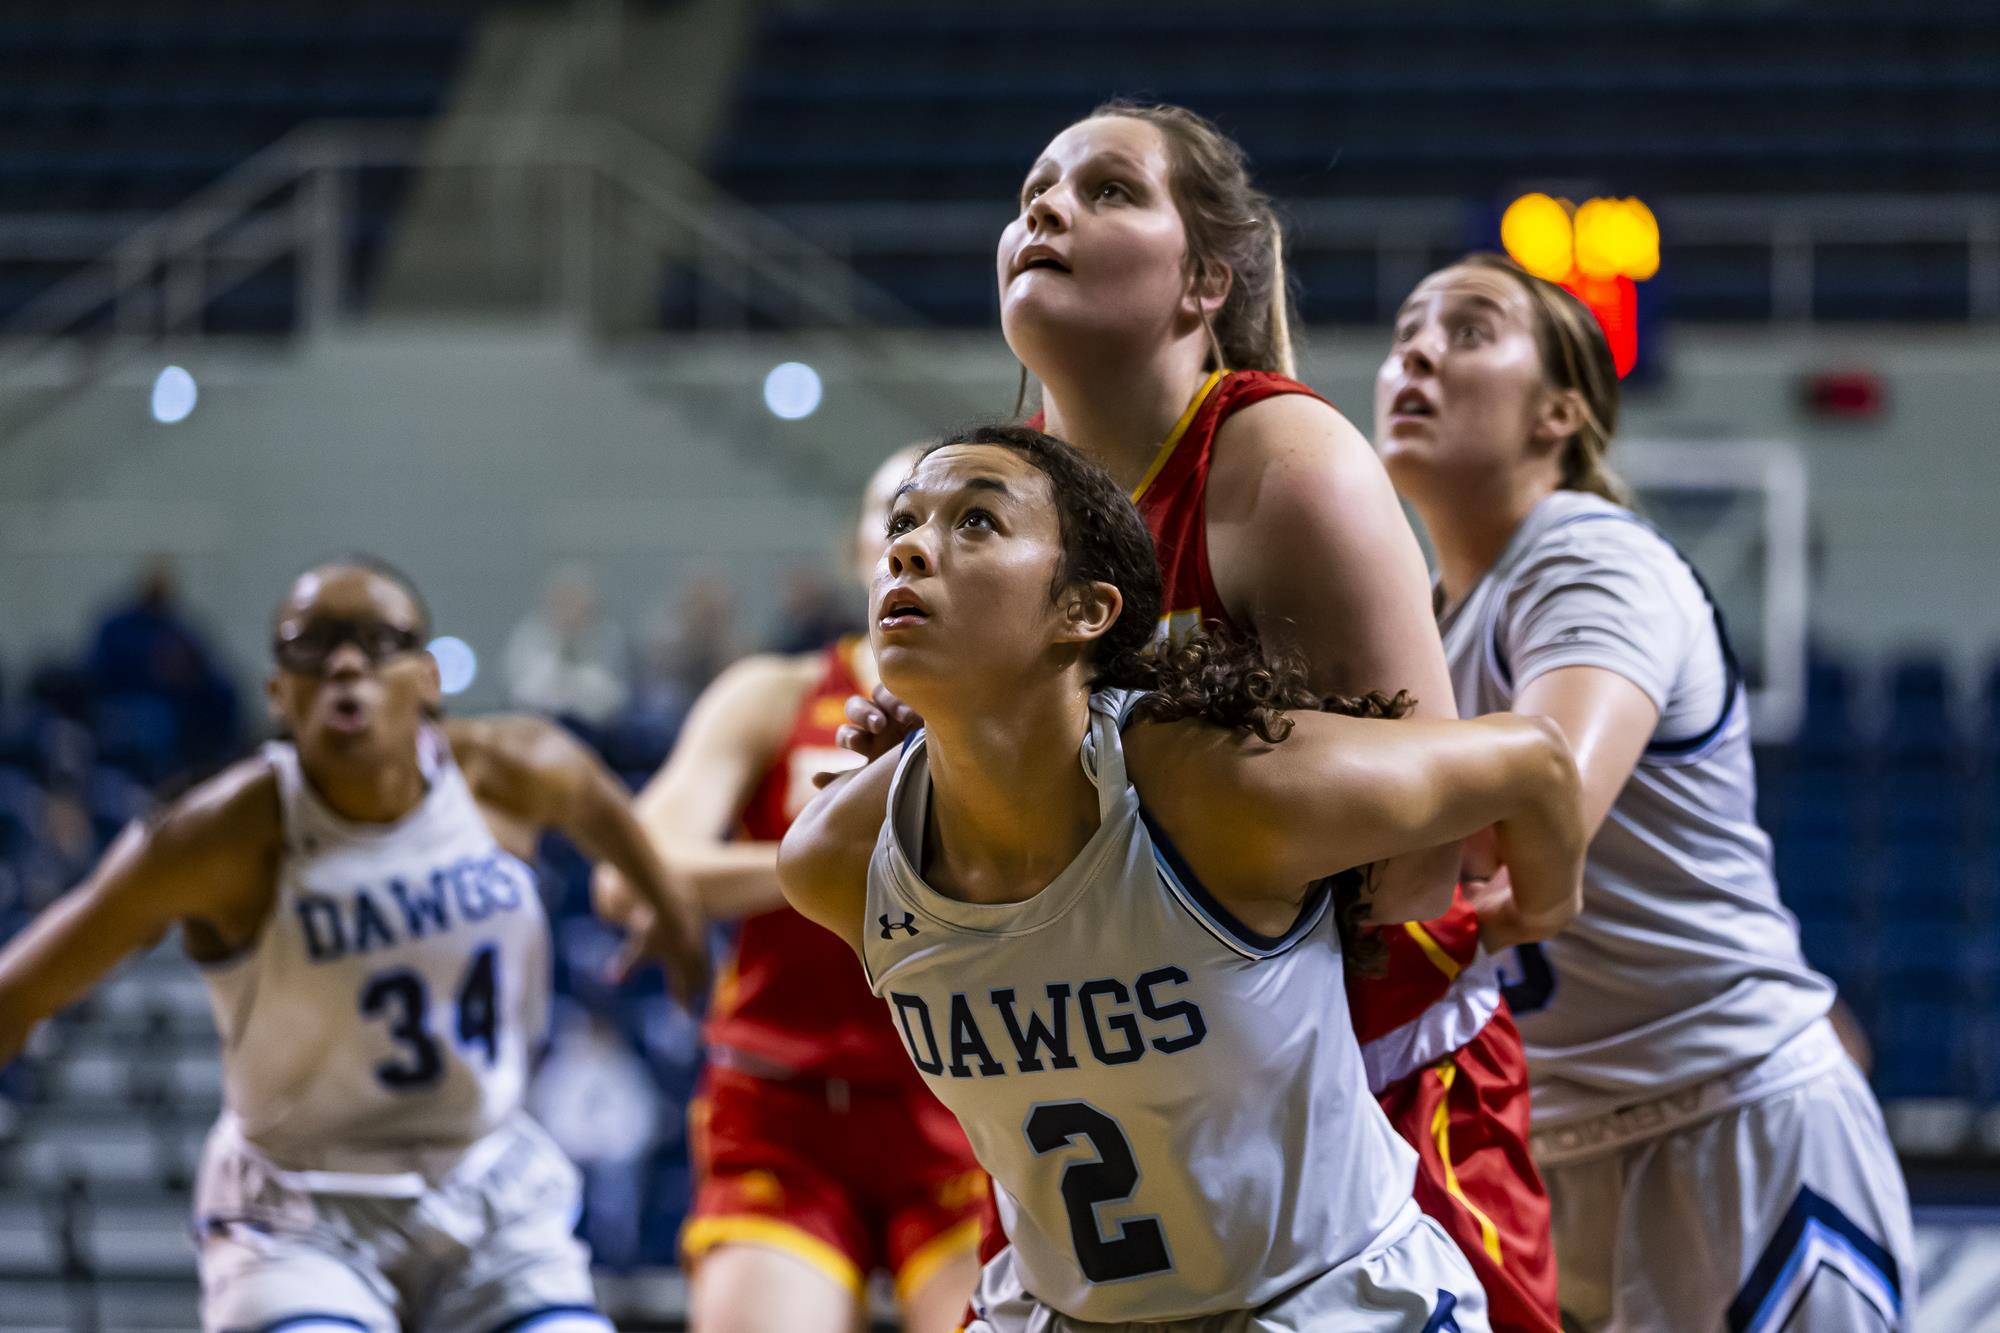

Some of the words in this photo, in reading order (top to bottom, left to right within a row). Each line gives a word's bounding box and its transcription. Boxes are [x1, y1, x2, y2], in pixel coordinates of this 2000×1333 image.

[297, 857, 521, 963] DAWGS
[360, 942, 498, 1090] 34
[890, 964, 1207, 1078] DAWGS
[1023, 1098, 1175, 1287] 2
